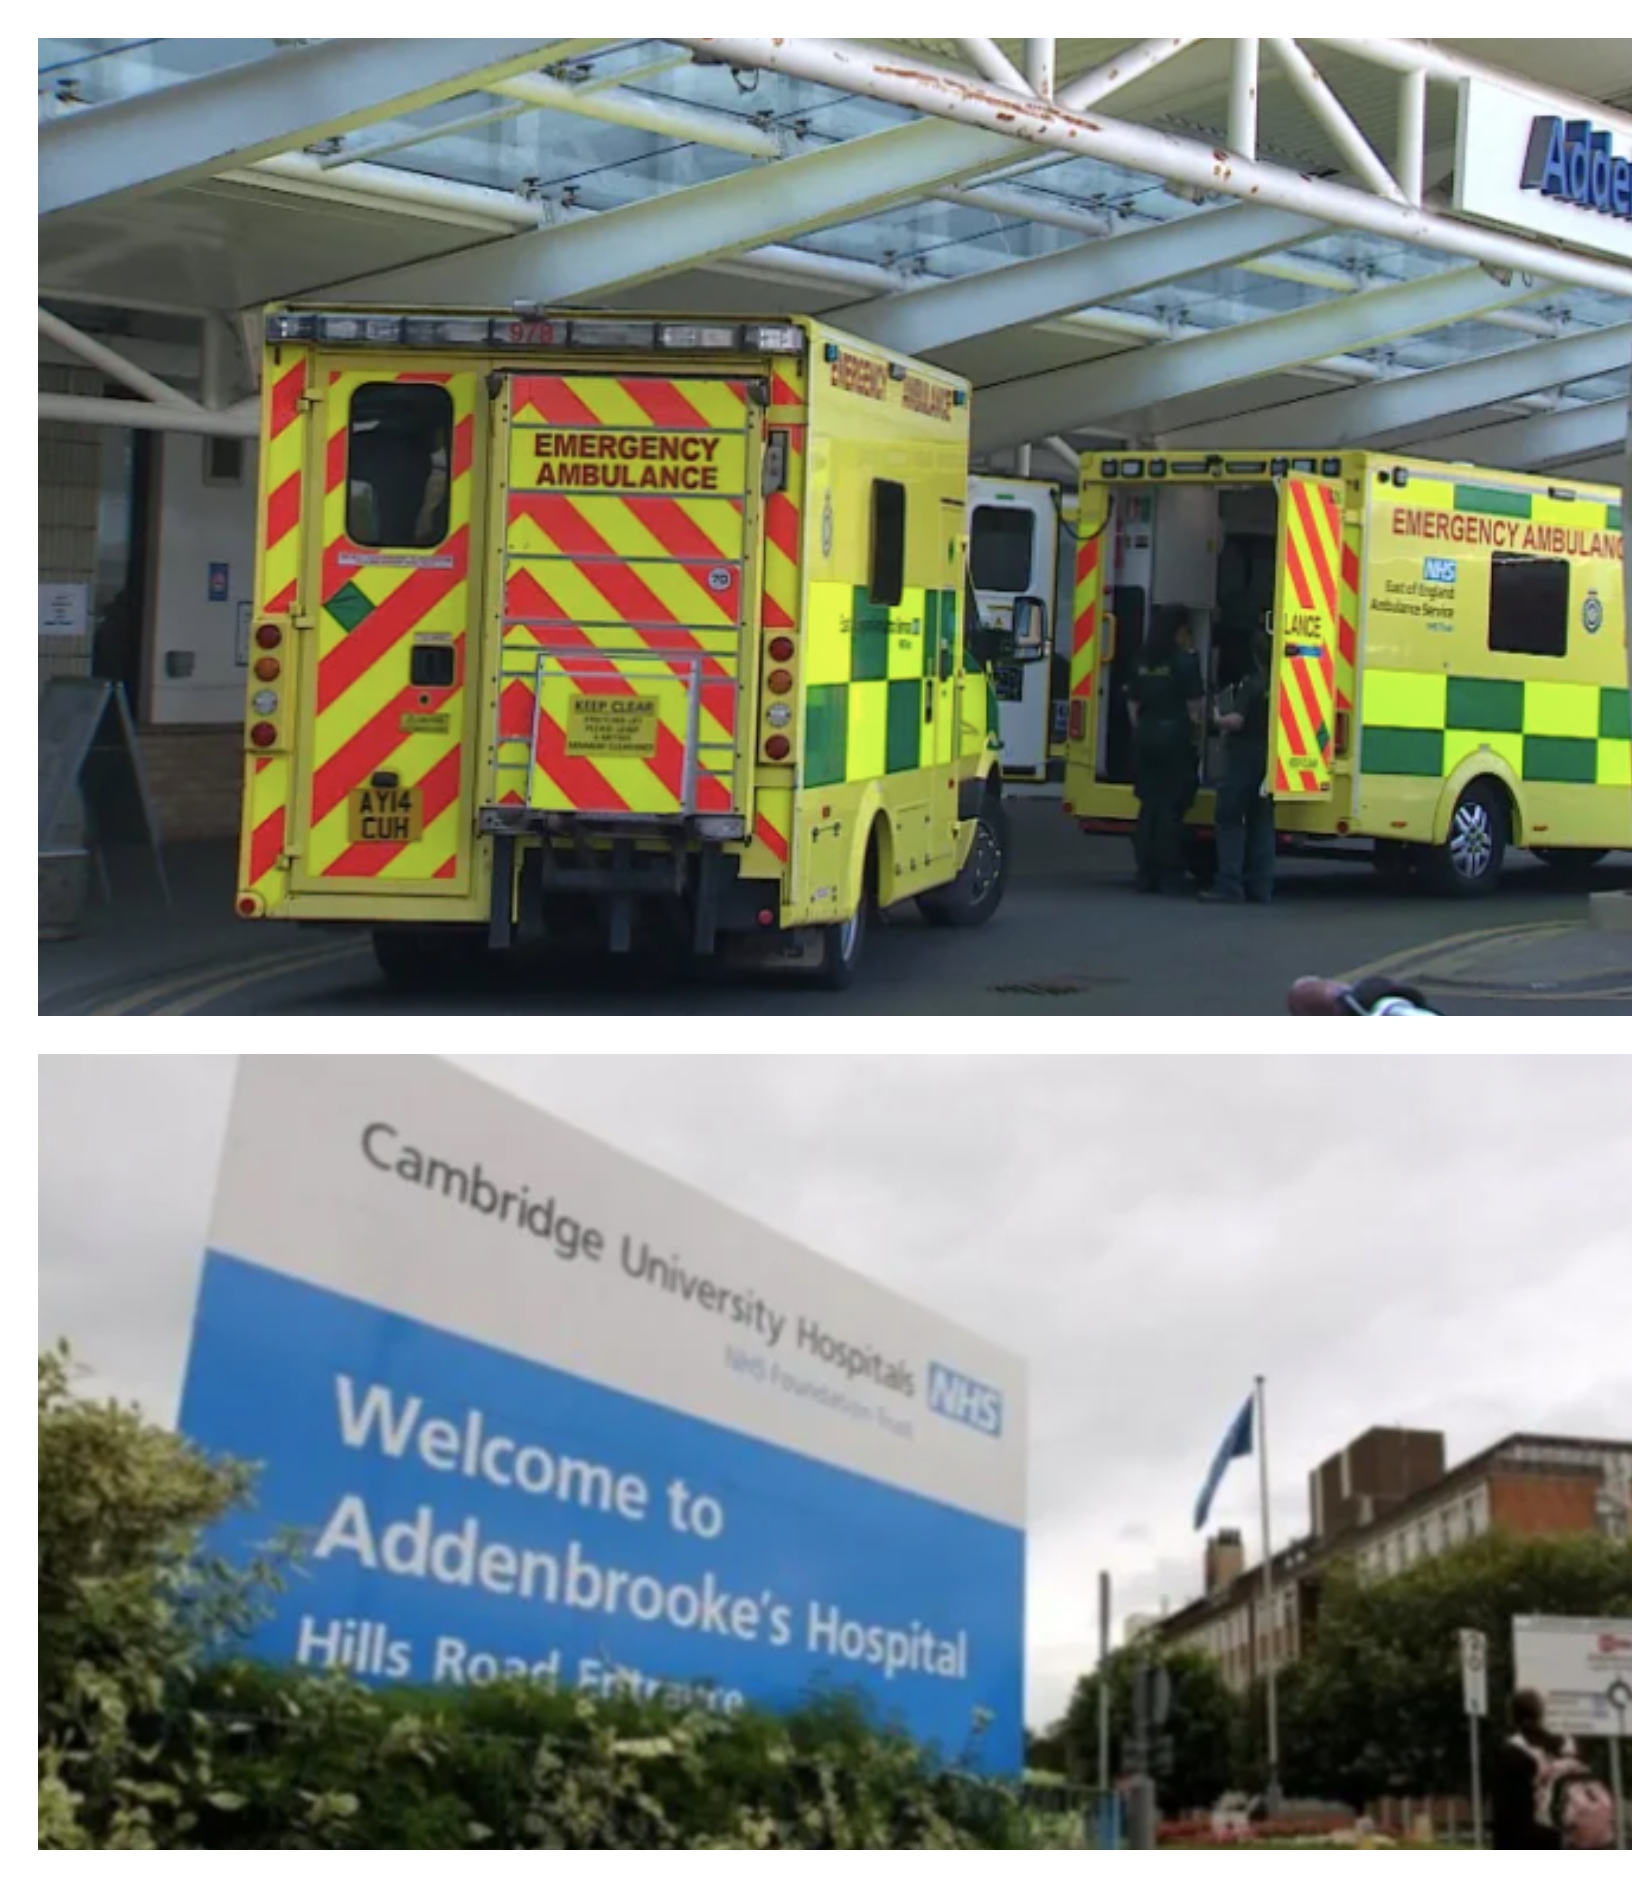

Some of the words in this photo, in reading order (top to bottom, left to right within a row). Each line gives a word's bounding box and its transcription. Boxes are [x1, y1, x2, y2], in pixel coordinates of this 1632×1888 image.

[831, 351, 887, 401] EMERGENCY
[534, 433, 719, 462] EMERGENCY
[536, 463, 718, 490] AMBULANCE
[1392, 508, 1519, 547] EMERGENCY
[1521, 525, 1624, 559] AMBULANC
[1424, 557, 1456, 583] NHS
[1386, 580, 1404, 595] East
[1406, 582, 1418, 595] of
[1418, 584, 1454, 602] England
[1371, 599, 1421, 616] Ambulance
[1422, 603, 1454, 618] Service
[1284, 613, 1321, 638] LANCE
[574, 700, 609, 713] KEEP
[611, 700, 655, 715] CLEAR
[360, 791, 412, 813] AY14
[361, 817, 409, 839] CUH
[361, 1122, 606, 1262] Cambridge
[620, 1235, 785, 1348] University
[797, 1316, 916, 1399] Hospitals
[928, 1361, 1003, 1439] NHS
[724, 1345, 765, 1382] NHS
[769, 1362, 873, 1422] Foundation
[876, 1404, 915, 1440] Trust
[335, 1374, 649, 1520] Welcome
[667, 1478, 724, 1539] to
[314, 1494, 792, 1648] Addenbrooke's
[807, 1601, 967, 1681] Hospital
[297, 1615, 411, 1678] Hills
[433, 1635, 561, 1697] Road
